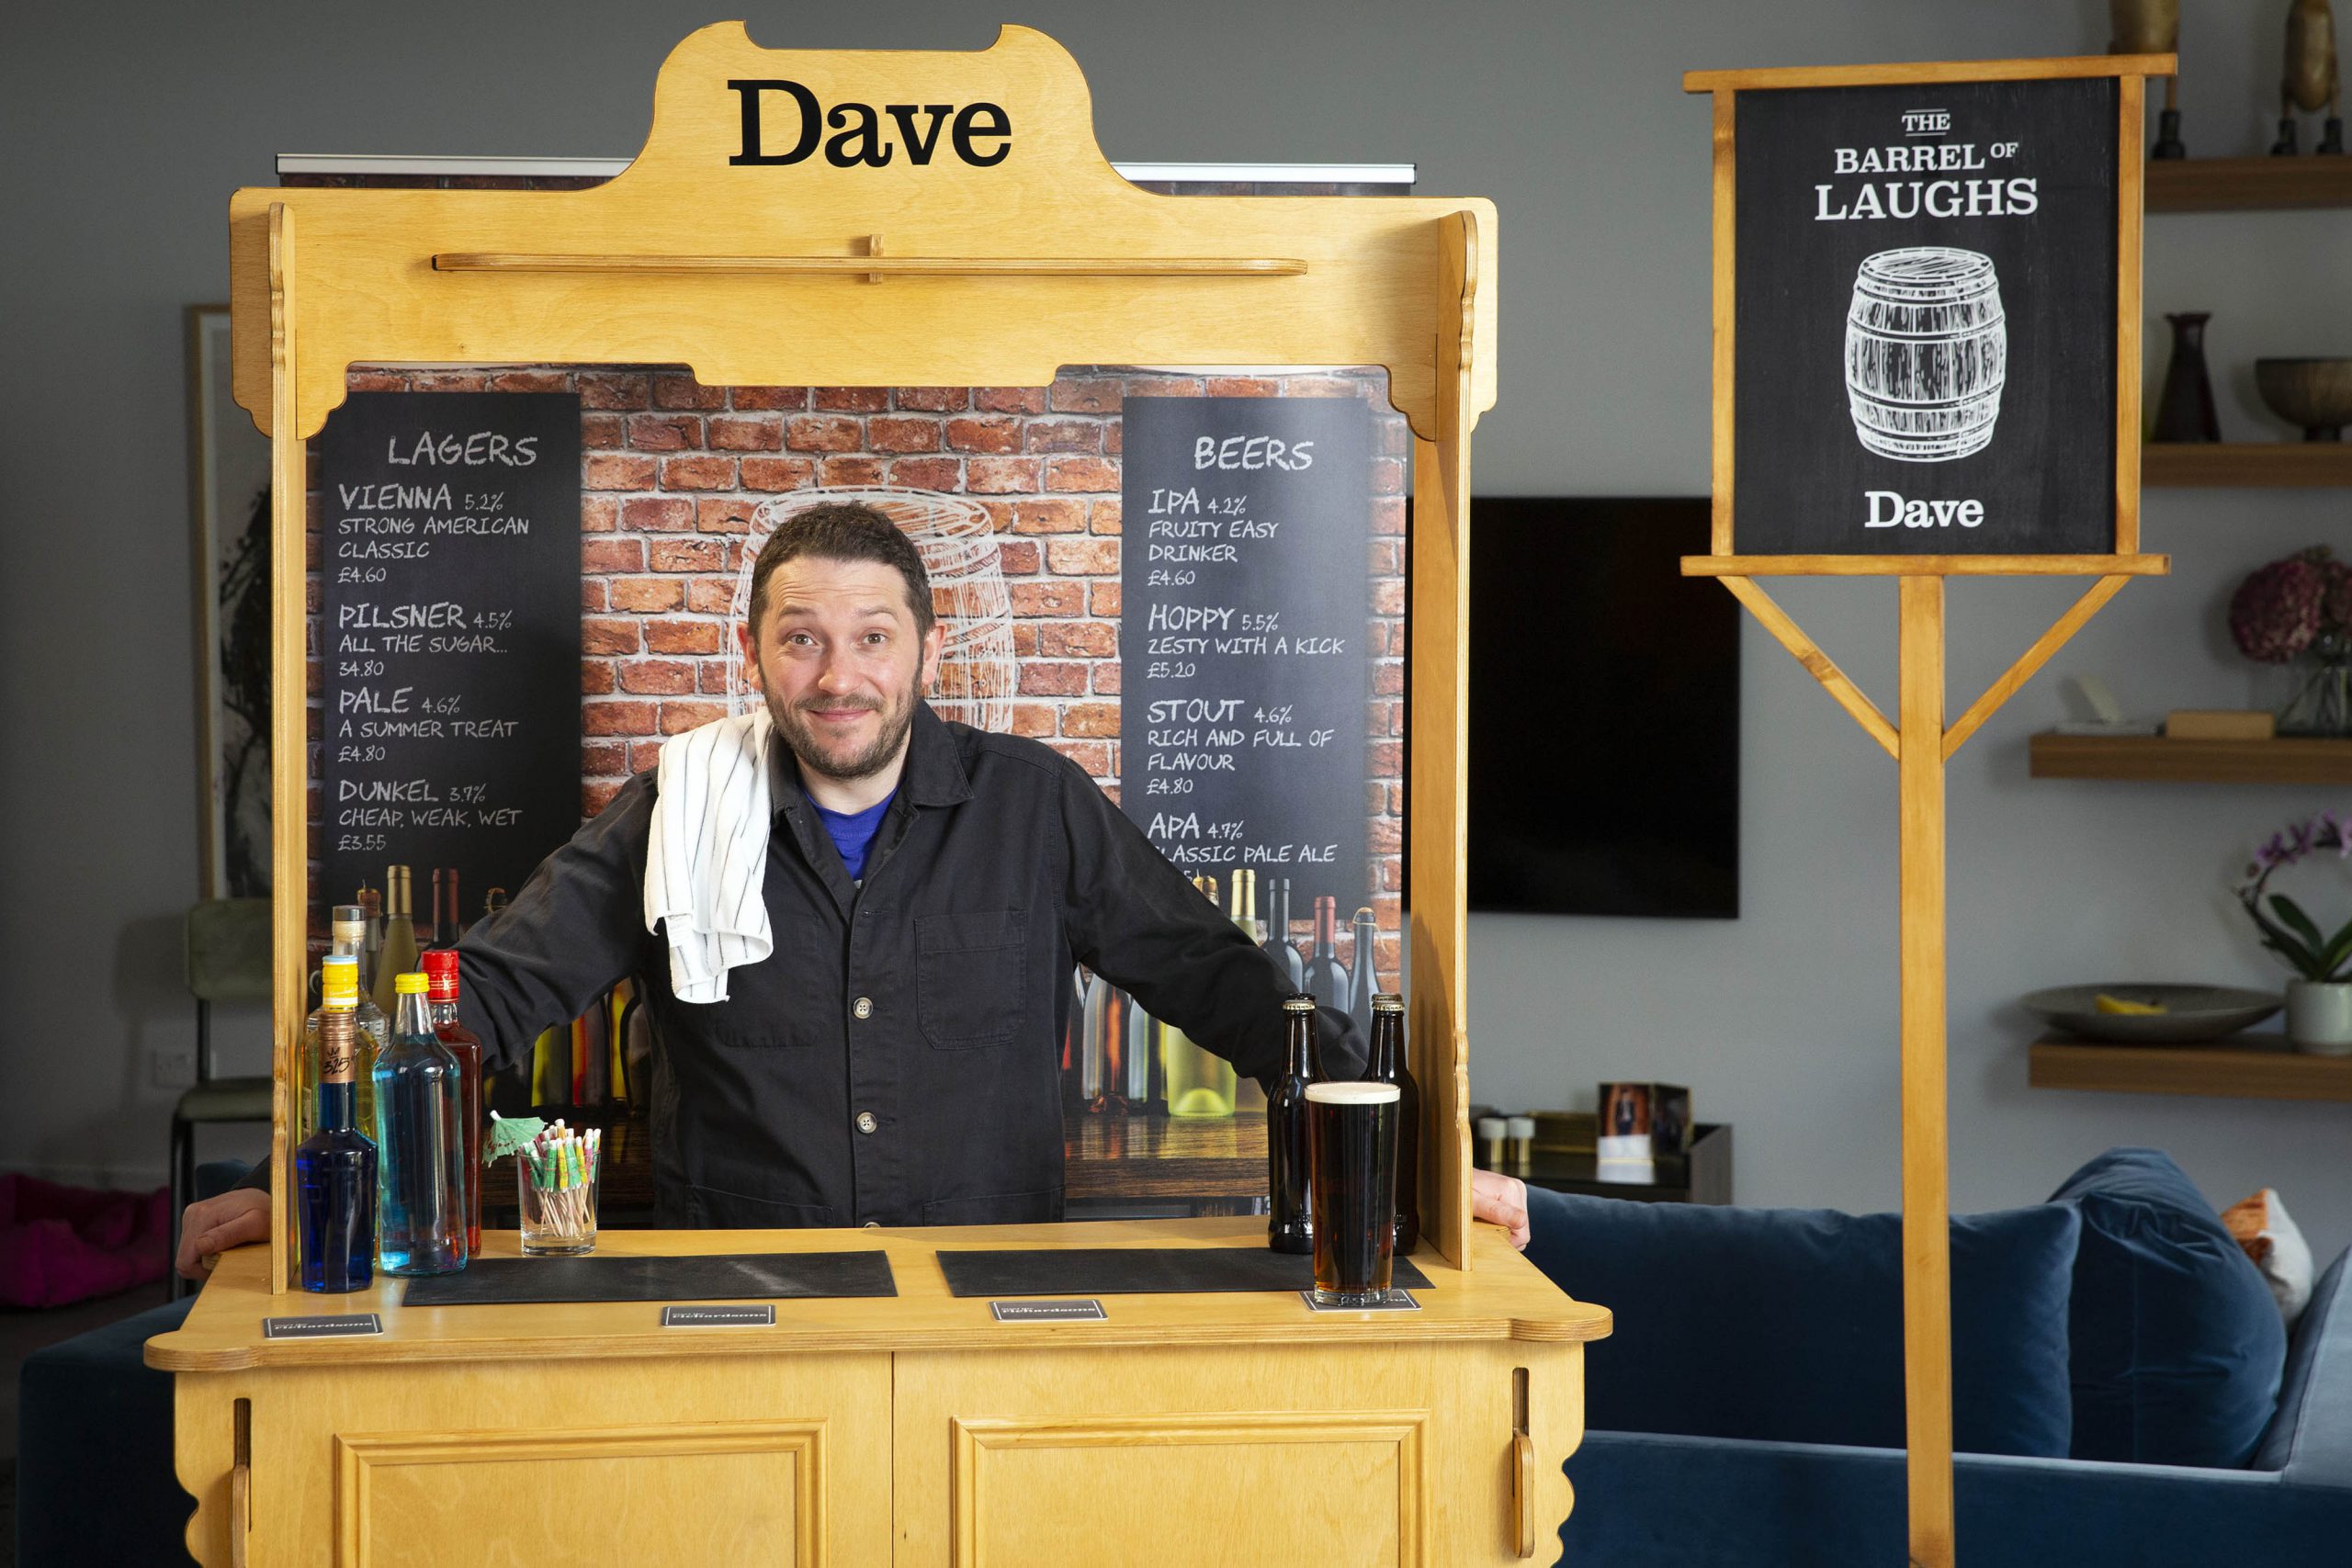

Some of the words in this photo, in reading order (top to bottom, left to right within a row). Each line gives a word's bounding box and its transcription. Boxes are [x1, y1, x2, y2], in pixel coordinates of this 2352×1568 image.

[728, 80, 1012, 167] Dave
[1902, 114, 1950, 131] THE
[1835, 144, 1984, 174] BARREL
[1991, 142, 2018, 158] OF
[1815, 178, 2038, 220] LAUGHS
[389, 432, 537, 466] LAGERS
[1194, 436, 1315, 470] BEERS
[339, 483, 451, 510] VIENNA
[465, 492, 503, 512] 5.2%
[1148, 488, 1199, 514] IPA
[1208, 496, 1247, 515] 4.2%
[1865, 491, 1984, 527] Dave
[339, 517, 414, 534] STRONG
[424, 516, 528, 535] AMERICAN
[1149, 520, 1222, 537] FRUITY
[1229, 520, 1279, 537] EASY
[339, 541, 429, 558] CLASSIC
[1149, 544, 1238, 562] DRINKER
[338, 567, 386, 582] £4.60
[1148, 570, 1195, 586] £4.60
[340, 602, 466, 628] PILSNER
[473, 610, 512, 630] 4.5%
[1148, 604, 1235, 631] HOPPY
[1242, 613, 1279, 632] 5.5%
[339, 635, 375, 652] ALL
[382, 635, 423, 652] THE
[429, 635, 508, 653] SUGAR...
[1148, 637, 1209, 654] ZESTY
[1216, 637, 1266, 654] WITH
[1275, 637, 1287, 654] A
[1296, 637, 1345, 654] KICK
[340, 660, 383, 676] 34.80
[1147, 662, 1195, 678] £5.20
[340, 687, 413, 714] PALE
[422, 695, 460, 715] 4.6%
[1148, 699, 1244, 723] STOUT
[1254, 705, 1292, 725] 4.6%
[339, 719, 352, 737] A
[360, 720, 444, 738] SUMMER
[450, 720, 518, 738] TREAT
[1148, 728, 1197, 747] RICH
[1205, 729, 1244, 746] AND
[1253, 729, 1301, 747] FULL
[1309, 729, 1334, 747] OF
[338, 745, 385, 761] £4.80
[1148, 752, 1235, 771] FLAVOUR
[340, 779, 438, 802] DUNKEL
[450, 784, 485, 803] 3.7%
[1147, 778, 1193, 795] £4.80
[479, 808, 522, 826] WET
[1148, 813, 1199, 839] APA
[1207, 820, 1243, 840] 4.7%
[338, 835, 386, 851] £3.55
[1245, 845, 1293, 863] PALE
[1298, 844, 1338, 862] ALE
